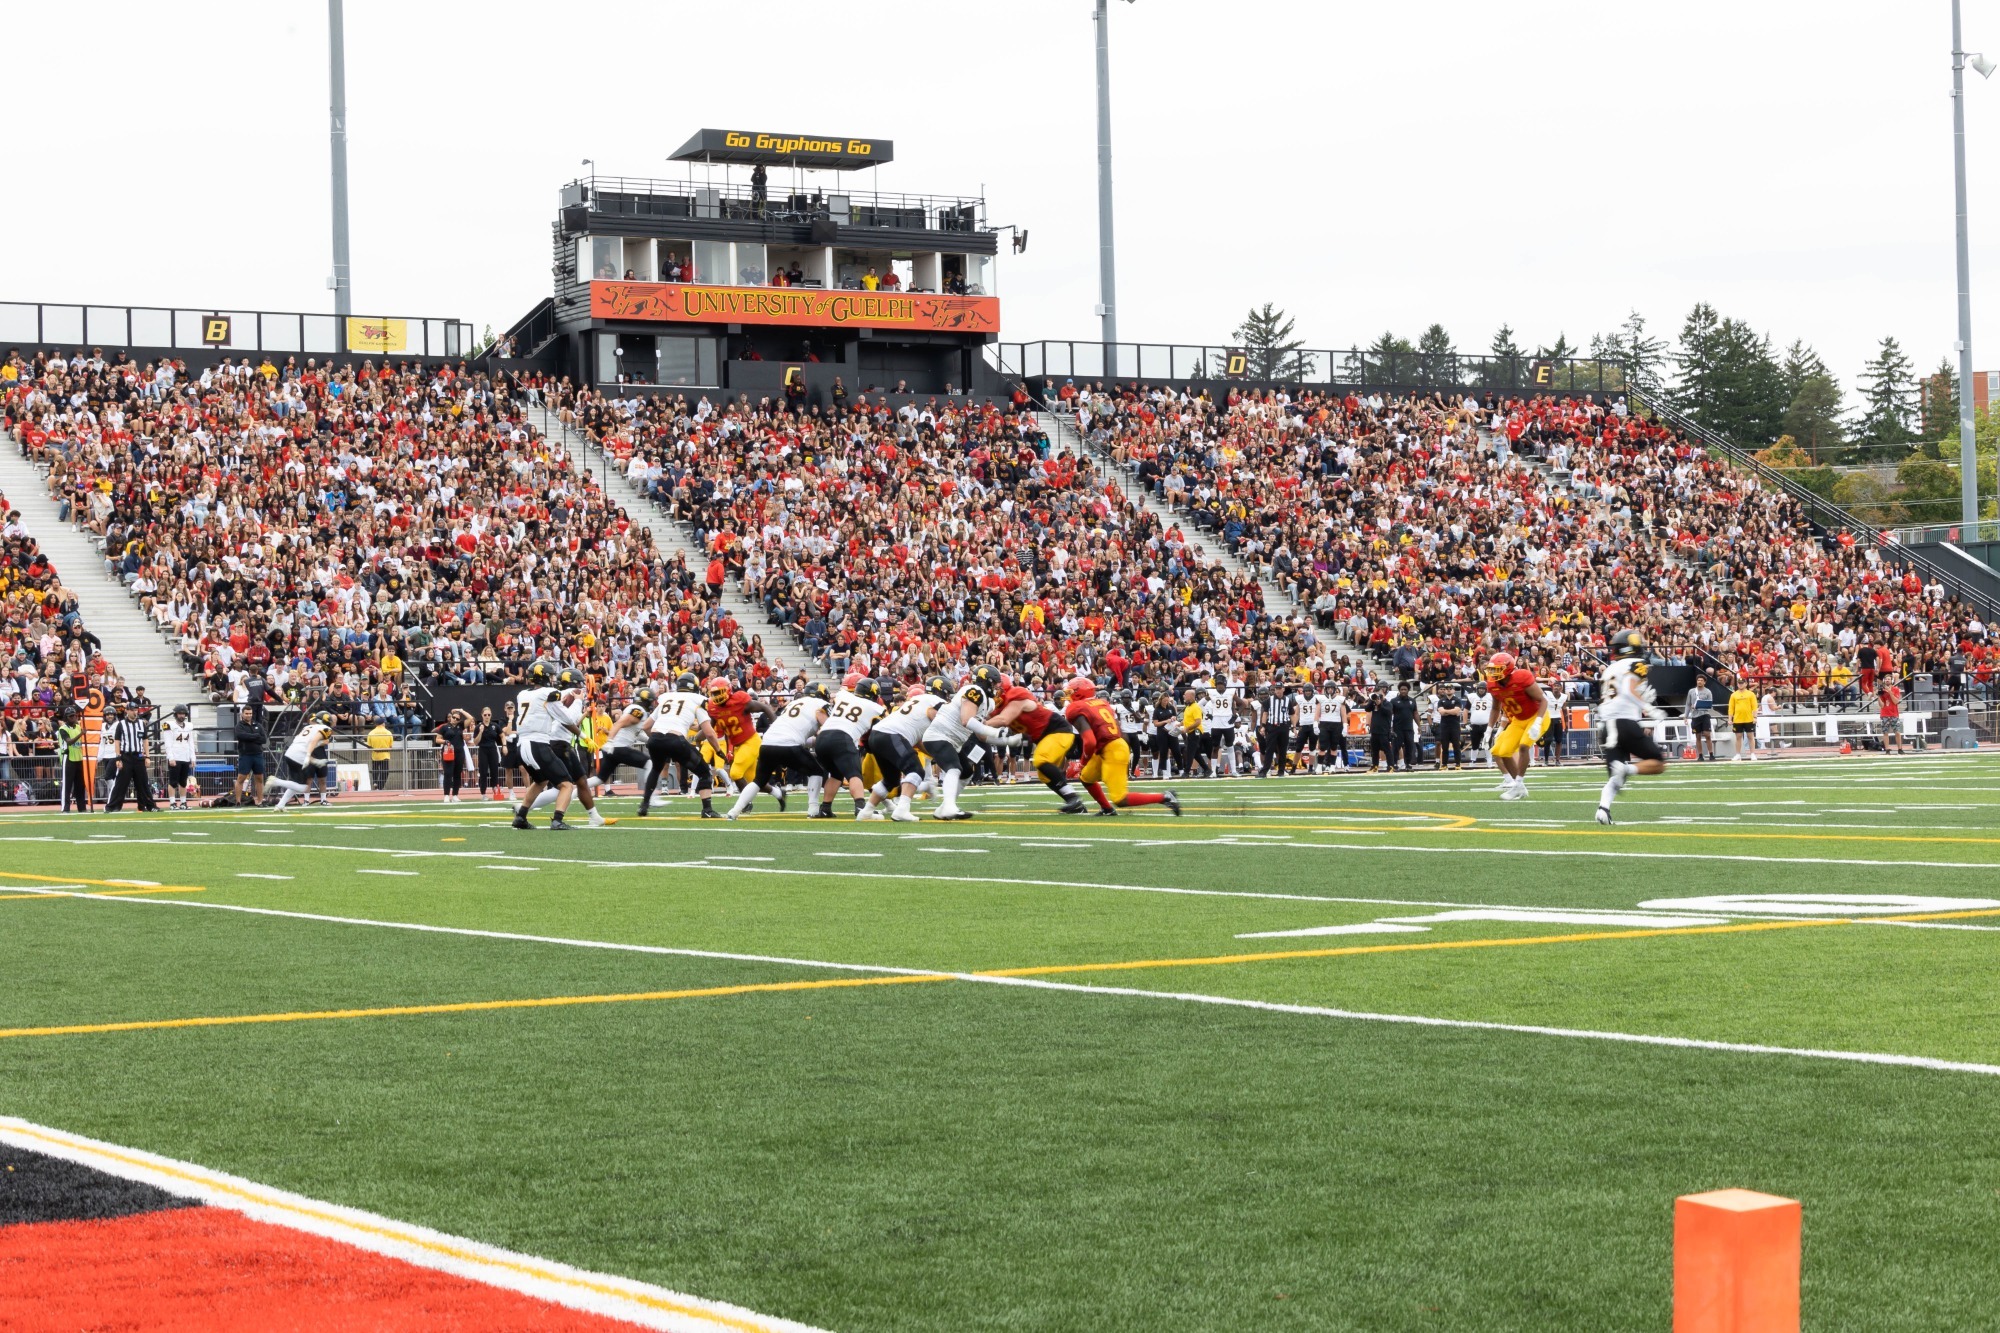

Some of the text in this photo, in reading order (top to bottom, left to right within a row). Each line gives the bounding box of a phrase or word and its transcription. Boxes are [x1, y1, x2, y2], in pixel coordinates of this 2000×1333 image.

[725, 132, 872, 155] Go Gryphons Go
[682, 290, 916, 323] UNIVERSITY of GUELPH
[205, 320, 228, 341] B
[1228, 355, 1246, 374] D
[1535, 365, 1551, 383] E
[73, 674, 87, 700] 2
[967, 688, 981, 702] 64
[660, 699, 686, 716] 61
[833, 701, 862, 723] 58
[1215, 698, 1229, 709] 96
[1302, 705, 1313, 714] 51
[1324, 704, 1337, 714] 97
[1475, 701, 1488, 711] 55
[518, 702, 530, 726] 7
[1098, 708, 1119, 735] 9
[1125, 714, 1135, 723] 15
